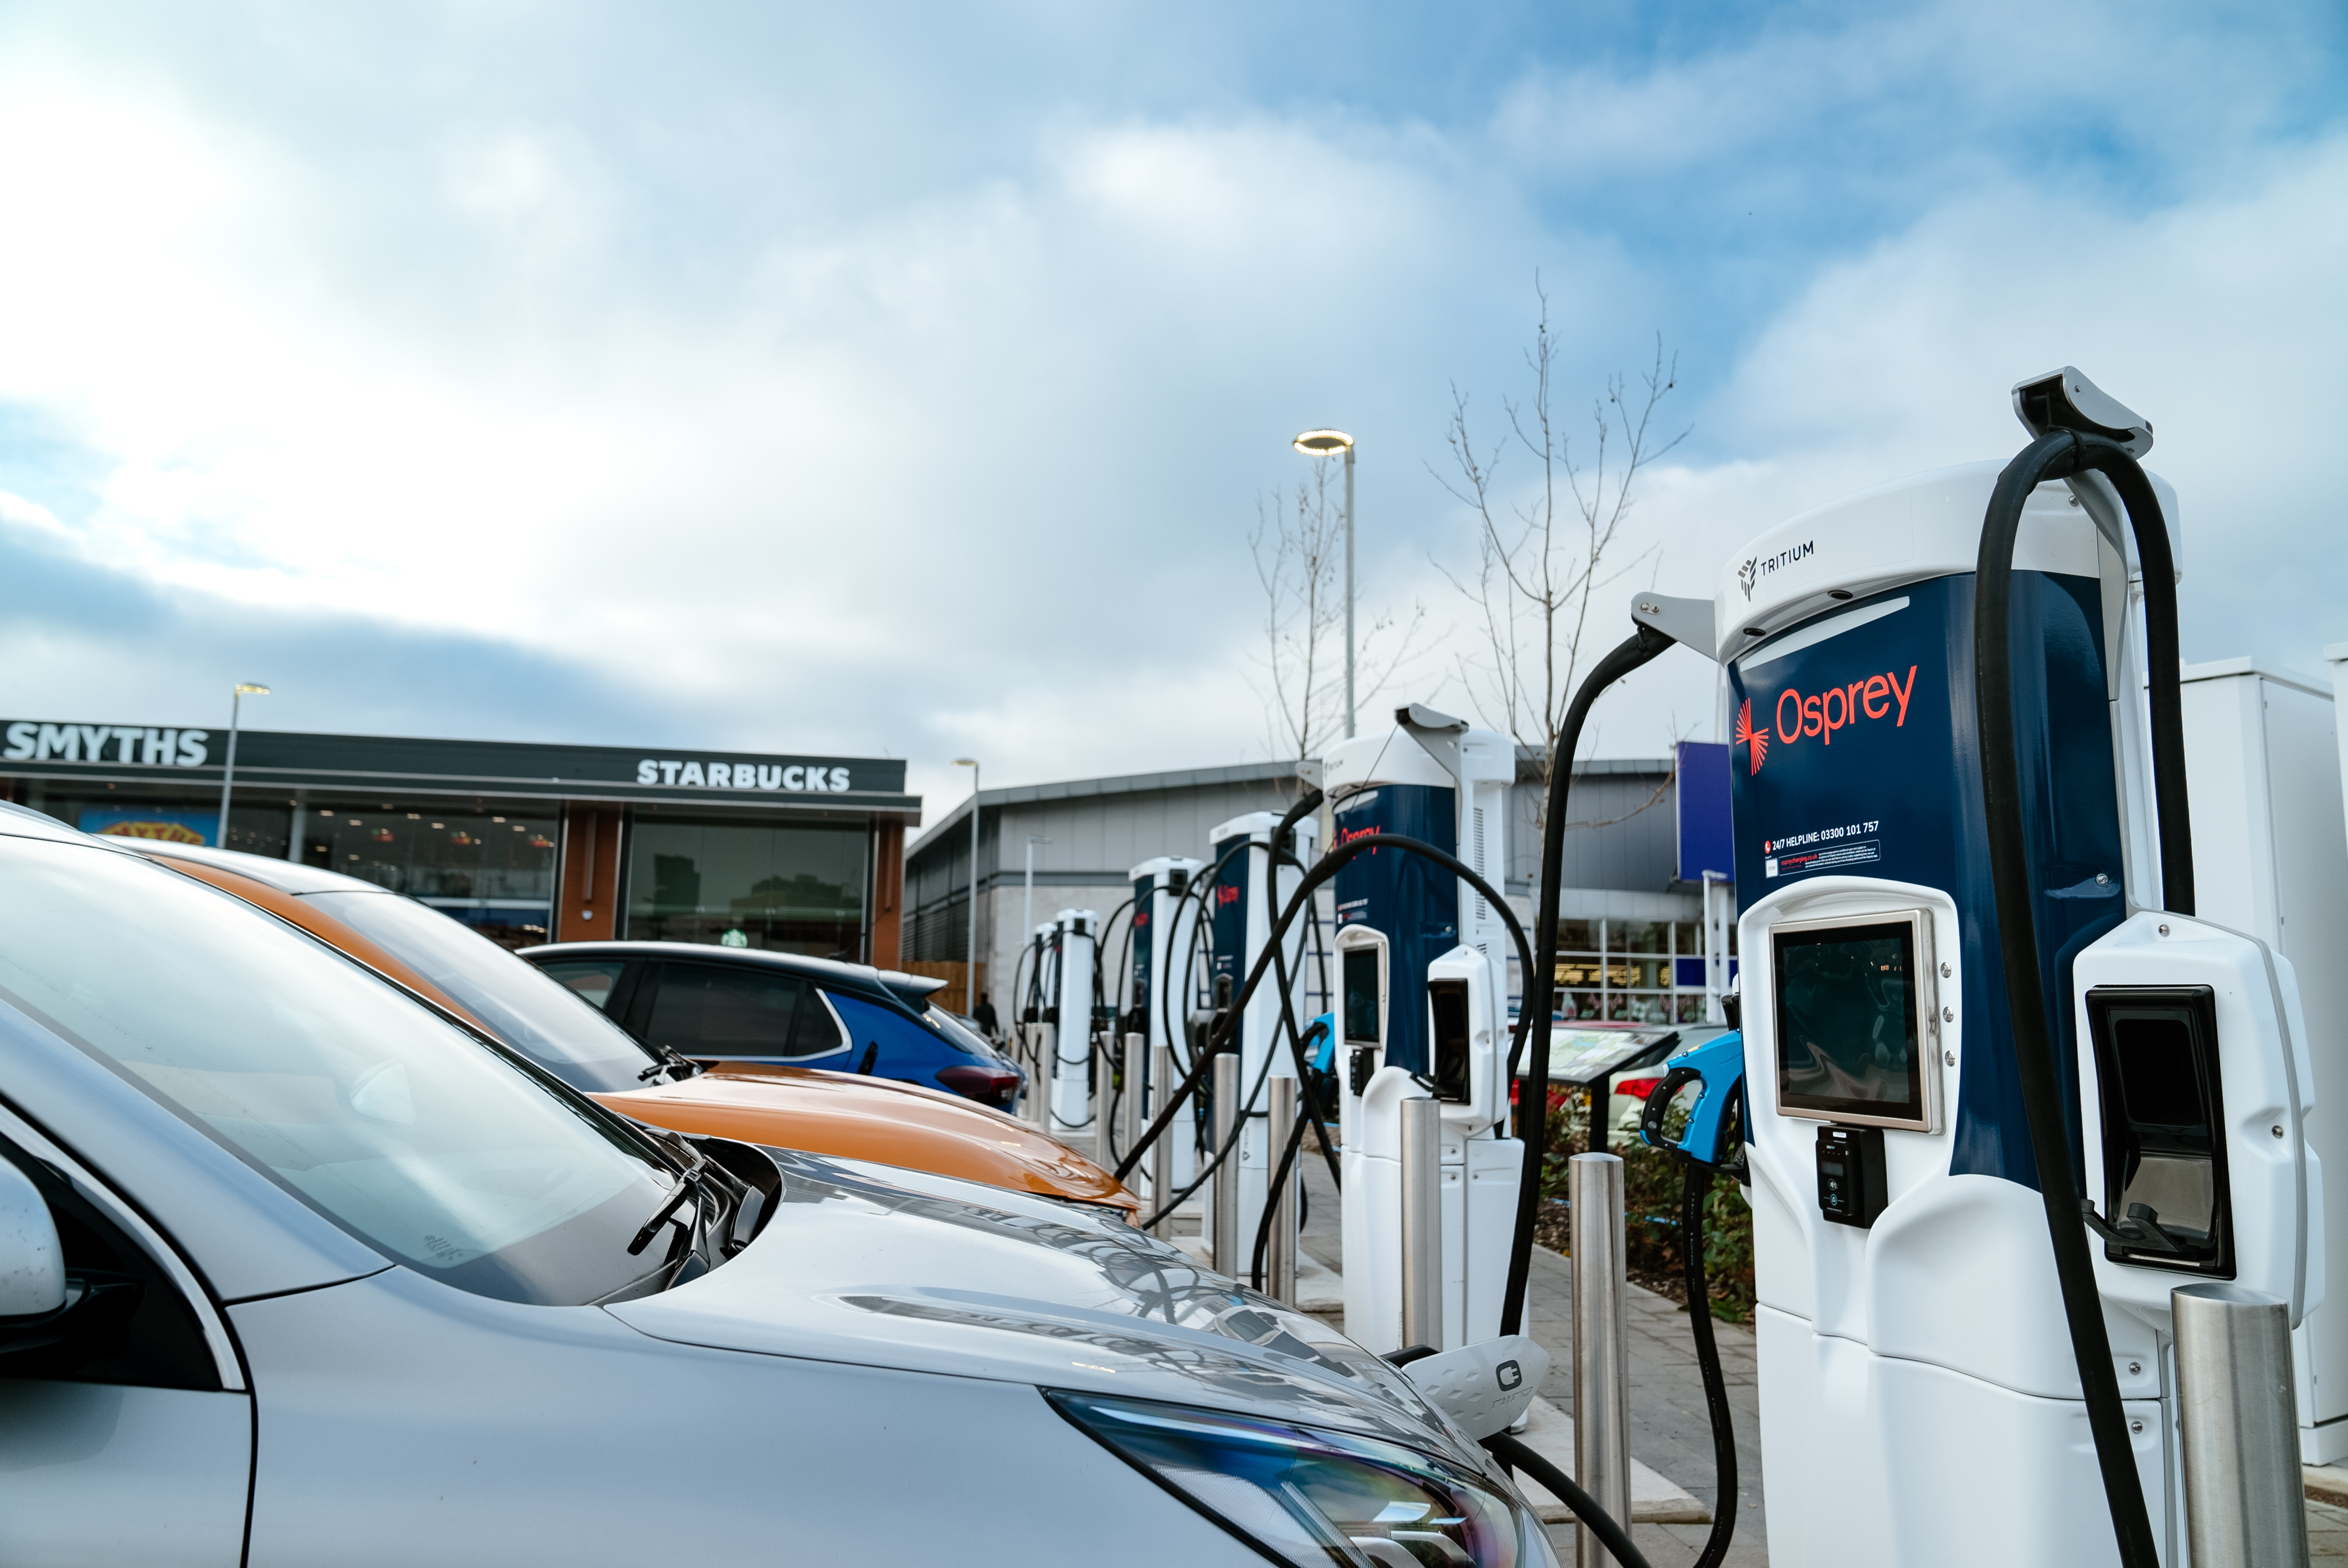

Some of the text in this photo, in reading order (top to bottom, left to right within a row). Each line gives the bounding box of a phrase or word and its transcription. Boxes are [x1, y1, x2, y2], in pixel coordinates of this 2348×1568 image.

[1760, 539, 1814, 576] TRITIUM
[1777, 665, 1918, 745] Osprey
[2, 721, 210, 767] SMYTHS
[636, 759, 851, 793] STARBUCKS
[1772, 821, 1879, 850] 24/7 HELPLINE: 03300 101 757
